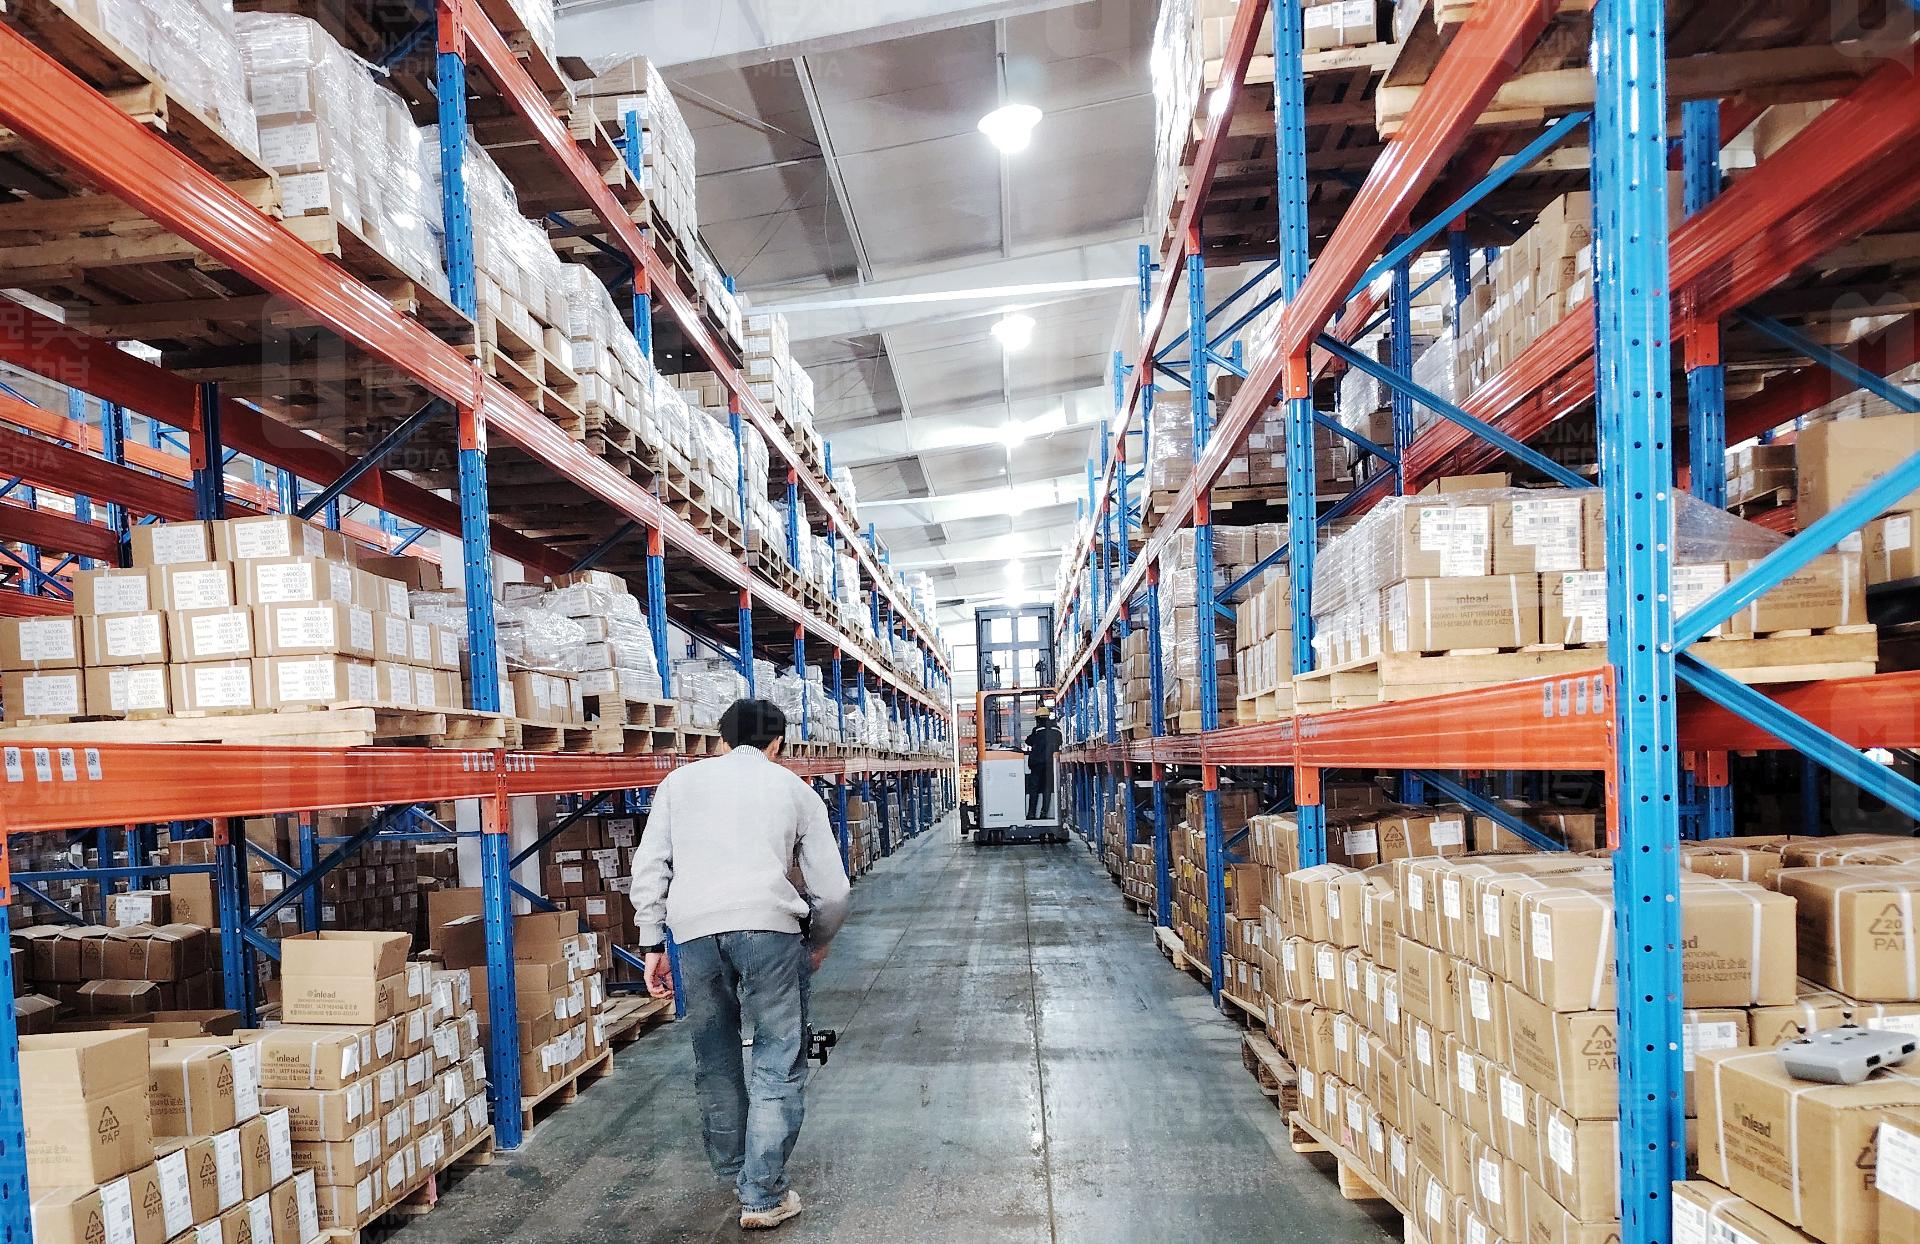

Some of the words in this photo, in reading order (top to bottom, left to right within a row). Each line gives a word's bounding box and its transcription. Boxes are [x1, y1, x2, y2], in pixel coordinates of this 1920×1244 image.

[1886, 918, 1902, 929] 20
[1875, 938, 1906, 951] PA
[1595, 1040, 1611, 1050] 20
[276, 1054, 300, 1063] inlead
[104, 1118, 114, 1127] 20
[102, 1130, 120, 1145] PAP
[292, 1152, 313, 1161] nlead
[149, 1192, 157, 1201] 20
[147, 1203, 162, 1219] PAP
[91, 1222, 99, 1233] 20
